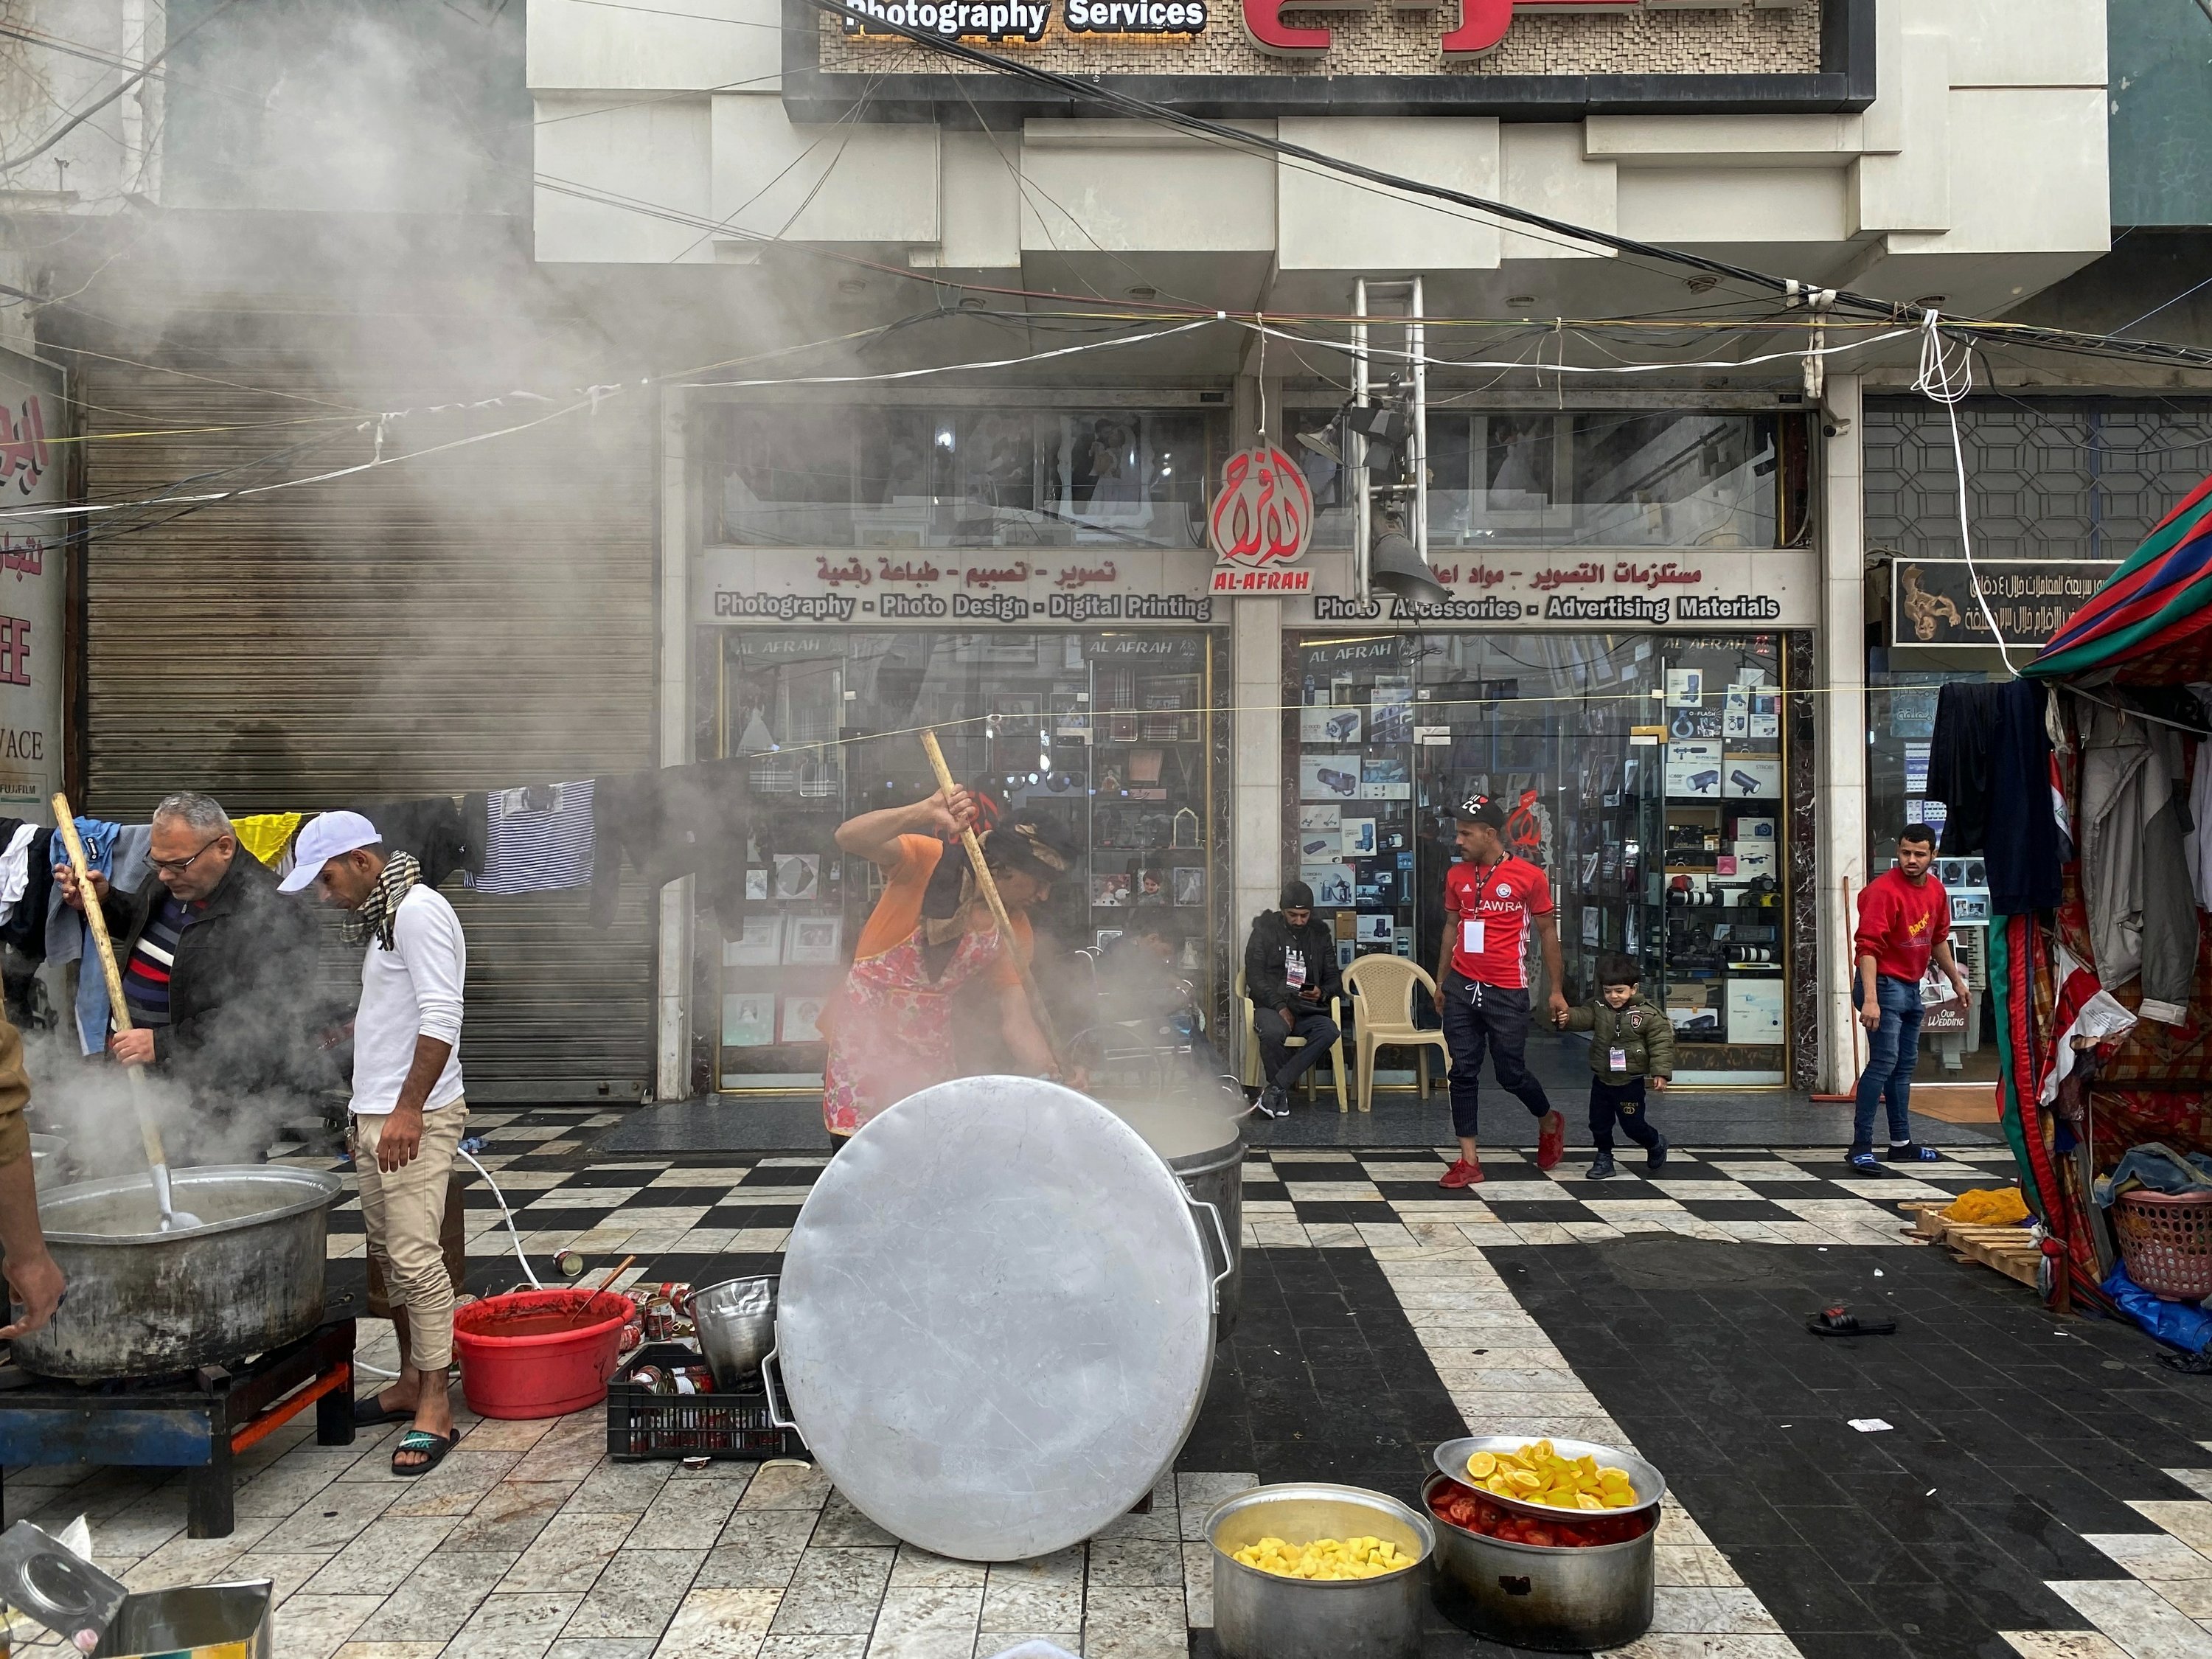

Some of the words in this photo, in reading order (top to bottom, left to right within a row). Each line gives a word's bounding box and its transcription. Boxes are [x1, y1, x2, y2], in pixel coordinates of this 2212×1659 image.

[1068, 0, 1203, 26] Services
[816, 557, 872, 587] رقمية
[878, 557, 939, 588] طباعة
[966, 561, 1026, 588] تصميم
[1054, 561, 1116, 588] تصوير
[1214, 571, 1310, 590] AL-AFRAH
[1469, 564, 1504, 588] مواد
[1529, 563, 1605, 590] التصوير
[1613, 563, 1703, 588] مستلزمات
[716, 593, 856, 621] Photography
[881, 594, 947, 620] Photo
[953, 594, 1029, 622] Design
[1049, 594, 1121, 621] Digital
[1126, 595, 1212, 621] Printing
[1316, 597, 1380, 619] Phoo
[1545, 595, 1669, 624] Advertising
[1677, 595, 1780, 620] Materials
[736, 641, 755, 655] AL
[762, 639, 820, 653] AFRAH
[1090, 641, 1109, 653] AL
[1115, 641, 1172, 653] AFRAH
[1309, 651, 1329, 664] AL
[1335, 643, 1391, 661] AFRAH
[1663, 638, 1683, 650] AL
[1688, 638, 1747, 650] AFRAH
[1927, 1014, 1964, 1027] WEDDING
